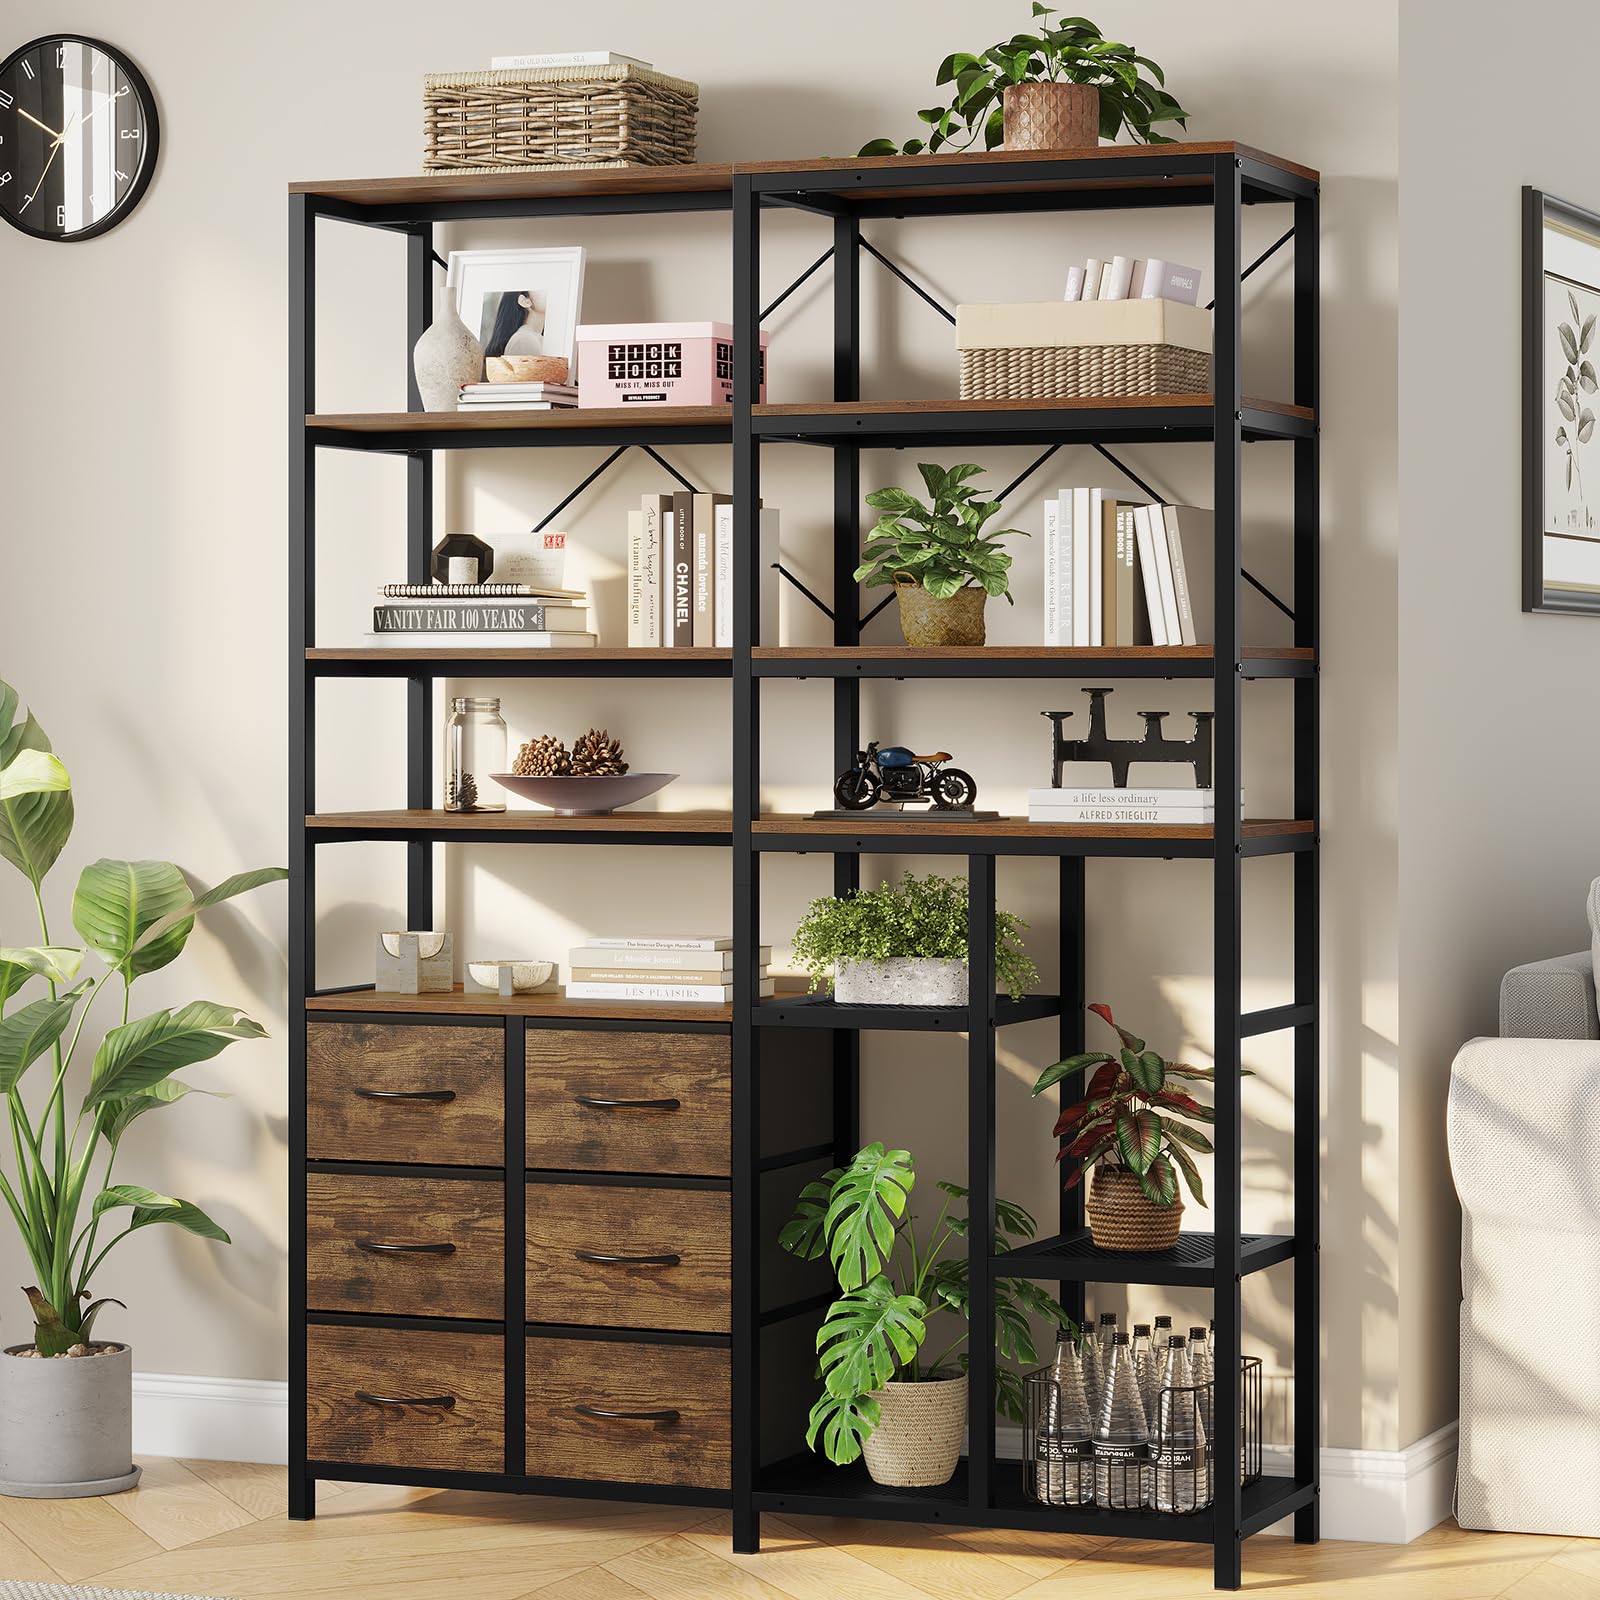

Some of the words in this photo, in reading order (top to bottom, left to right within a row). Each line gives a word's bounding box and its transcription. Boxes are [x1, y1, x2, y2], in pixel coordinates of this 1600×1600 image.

[120, 129, 140, 139] 3
[613, 345, 677, 360] TICK
[613, 363, 677, 377] TOCK
[633, 536, 642, 571] Arianna
[698, 533, 708, 570] amanda
[631, 574, 642, 625] Huffington
[676, 562, 689, 628] CHANEL
[698, 573, 709, 612] lovelace
[375, 609, 424, 630] VANITY
[426, 609, 457, 630] FAIR
[460, 609, 479, 630] 100
[482, 608, 525, 630] YEARS
[1081, 793, 1096, 803] life
[1098, 793, 1116, 803] less
[1118, 794, 1159, 806] ordinary
[1079, 810, 1113, 820] ALFRED
[1115, 811, 1159, 821] STIEGLITZ
[625, 987, 645, 996] LES
[649, 988, 700, 998] PLAISIRS
